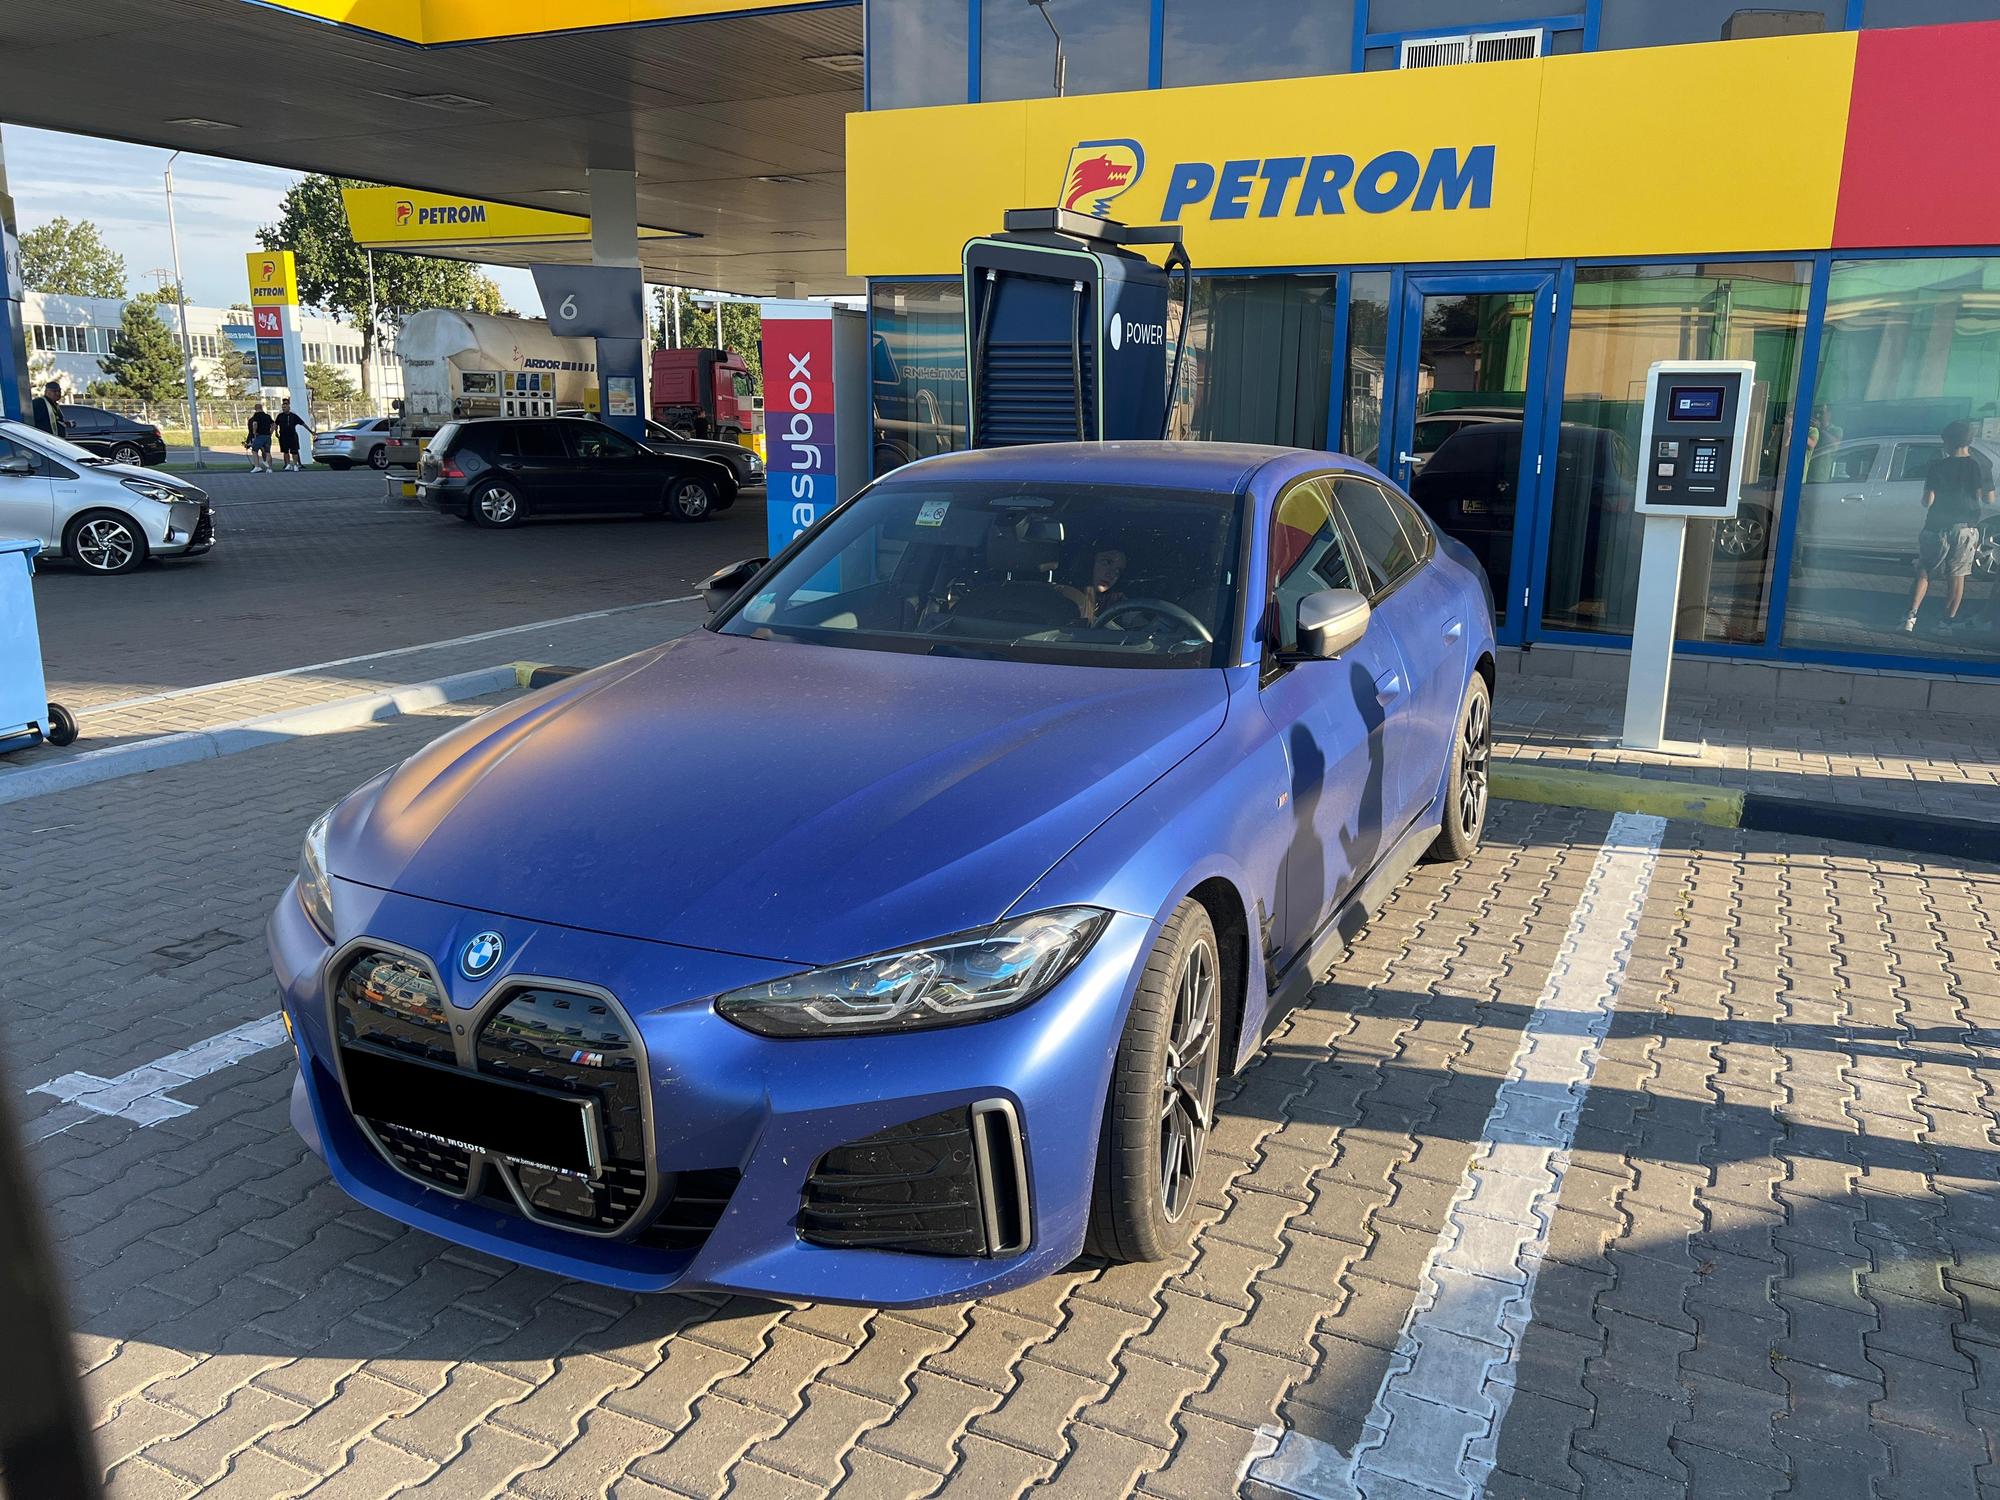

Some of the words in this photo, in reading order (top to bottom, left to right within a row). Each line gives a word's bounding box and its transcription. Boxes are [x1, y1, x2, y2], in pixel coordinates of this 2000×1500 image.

[1160, 145, 1495, 222] PETROM
[418, 205, 486, 224] PETROM
[253, 287, 285, 297] PETROM
[559, 294, 578, 320] 6
[1126, 322, 1163, 345] POWER
[524, 358, 560, 371] ARDOR
